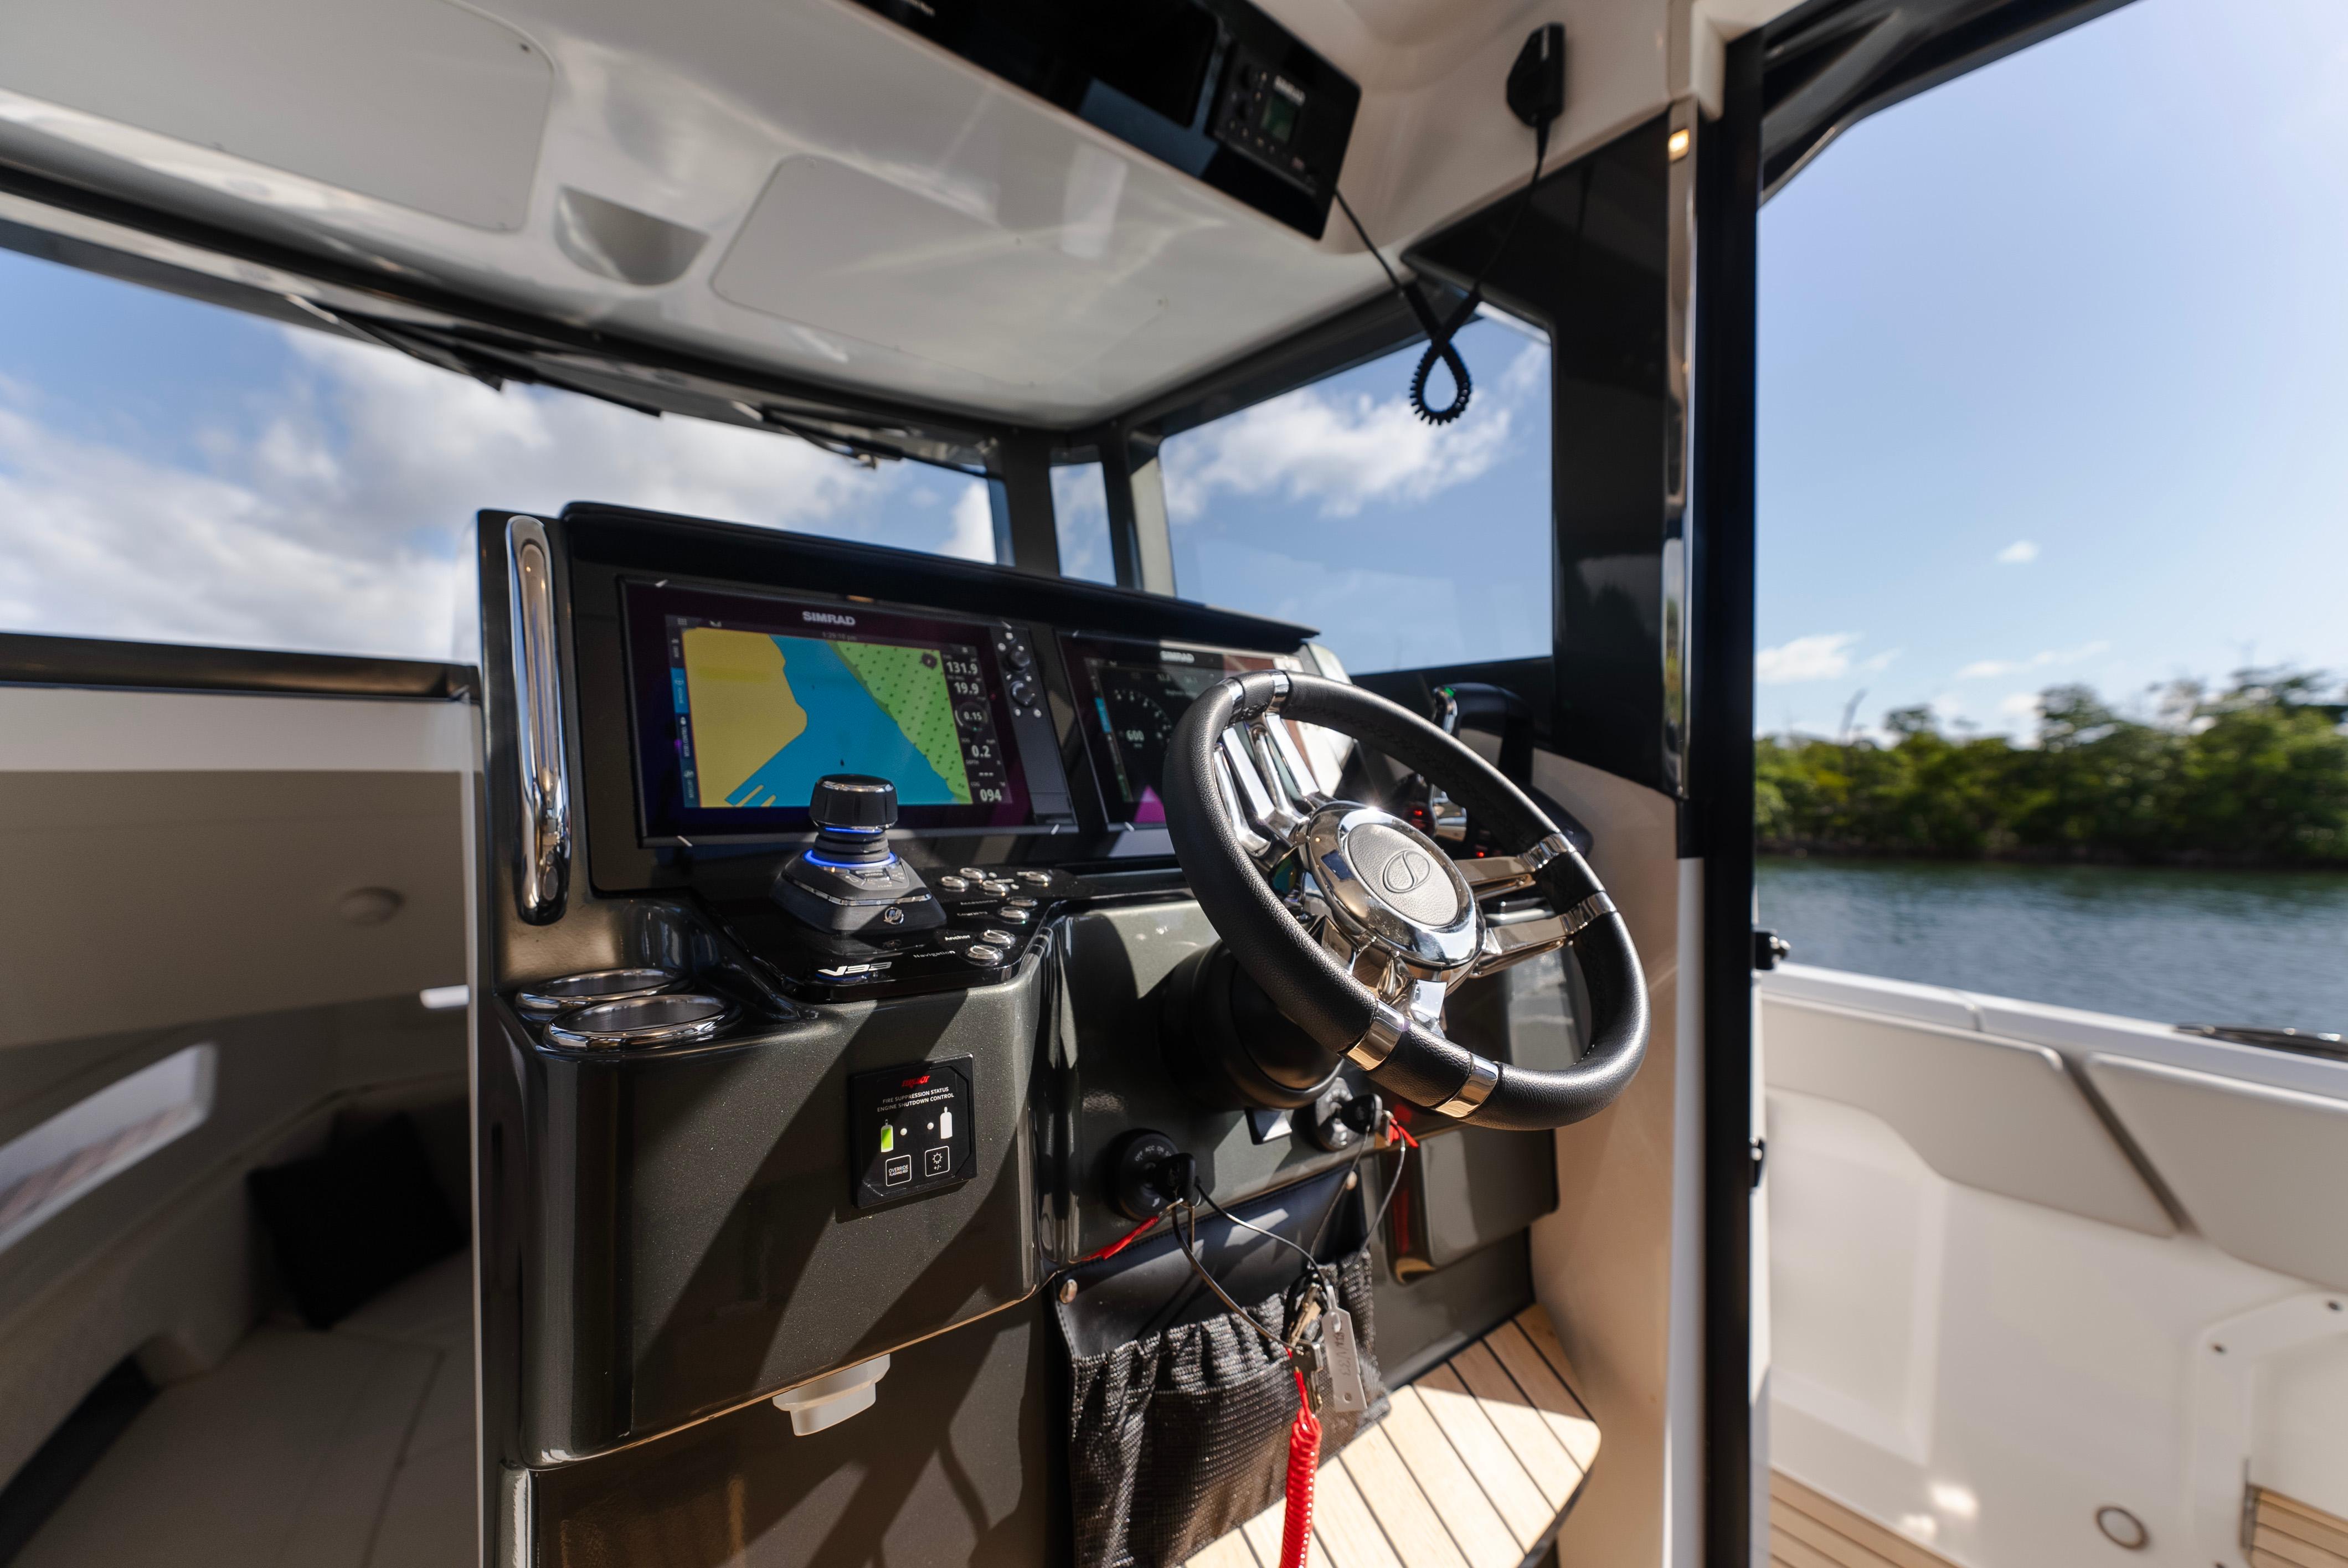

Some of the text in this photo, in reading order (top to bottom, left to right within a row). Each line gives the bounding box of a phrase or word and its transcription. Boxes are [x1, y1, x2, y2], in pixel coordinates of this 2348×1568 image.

[802, 611, 856, 626] SIMRAD
[946, 661, 978, 675] 131.9
[954, 682, 979, 695] 19.9
[963, 711, 982, 721] 0.15
[971, 745, 991, 759] 0.2
[980, 788, 1002, 802] 094
[817, 962, 892, 976] V33
[895, 1090, 930, 1102] SUPPRESSION
[930, 1086, 949, 1095] STATUS
[877, 1092, 955, 1112] ENGINE SHUTDOWN CONTROL
[888, 1164, 909, 1173] OVERRIDE
